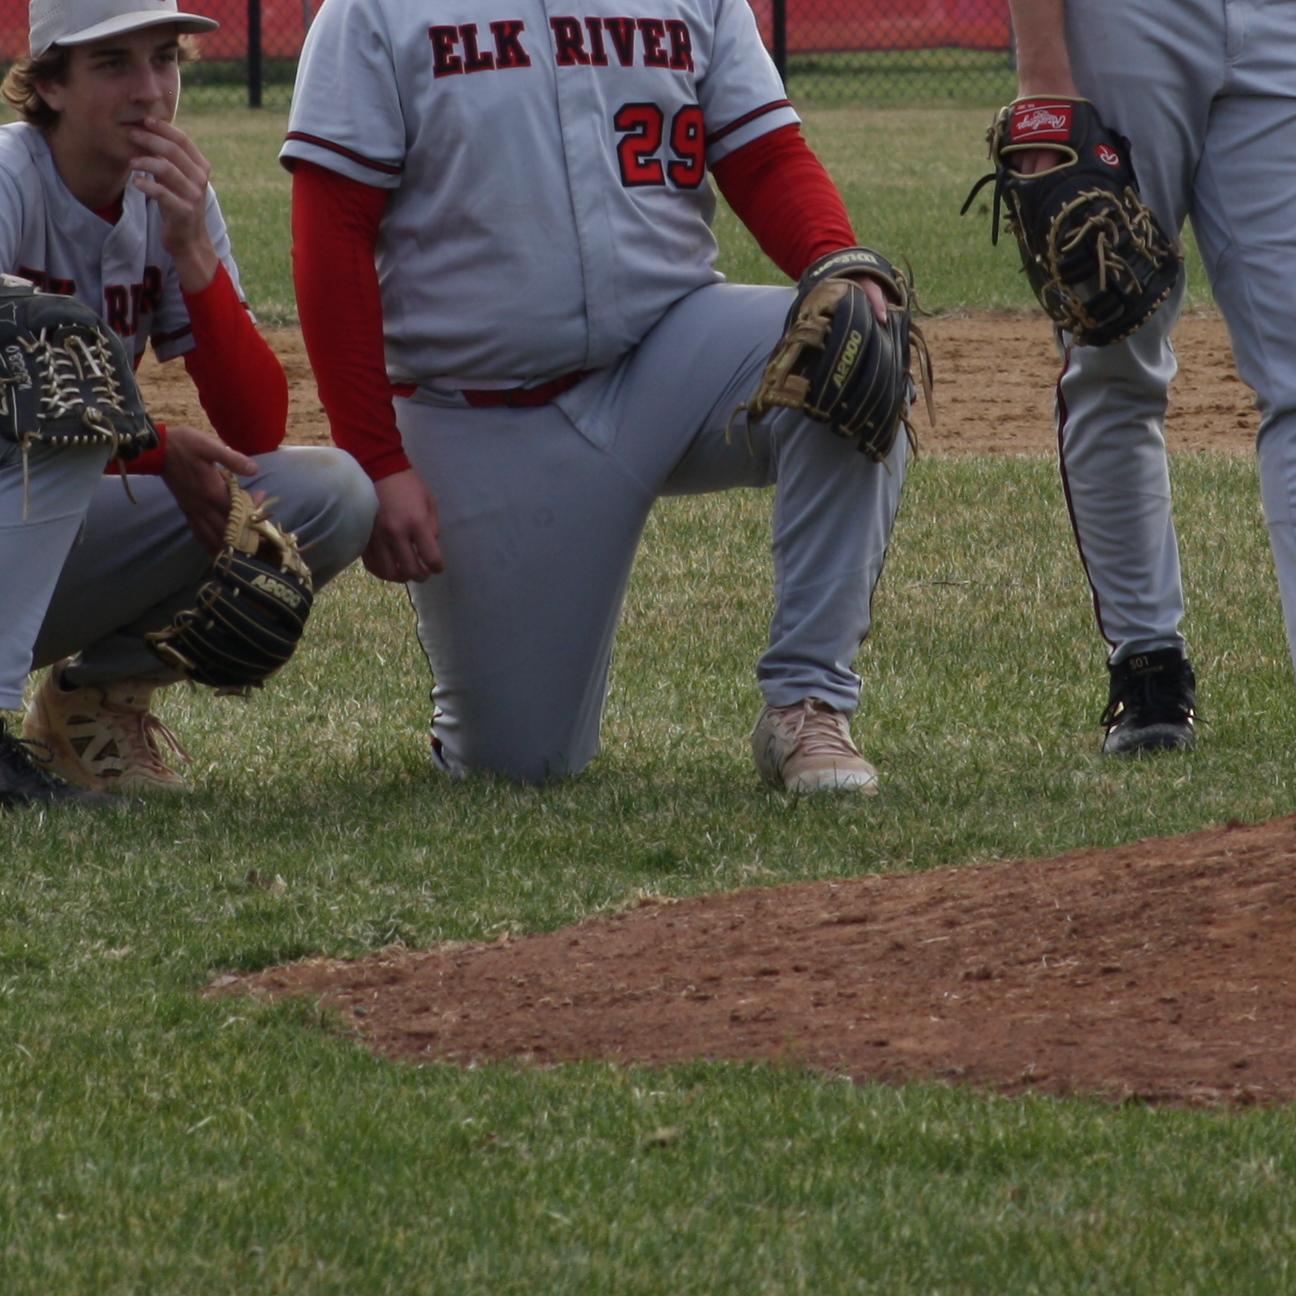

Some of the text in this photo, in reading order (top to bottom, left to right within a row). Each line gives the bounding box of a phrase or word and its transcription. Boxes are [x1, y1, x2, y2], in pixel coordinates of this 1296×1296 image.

[428, 16, 695, 79] ELK RIVER
[613, 102, 705, 190] 29
[831, 329, 863, 389] A2000
